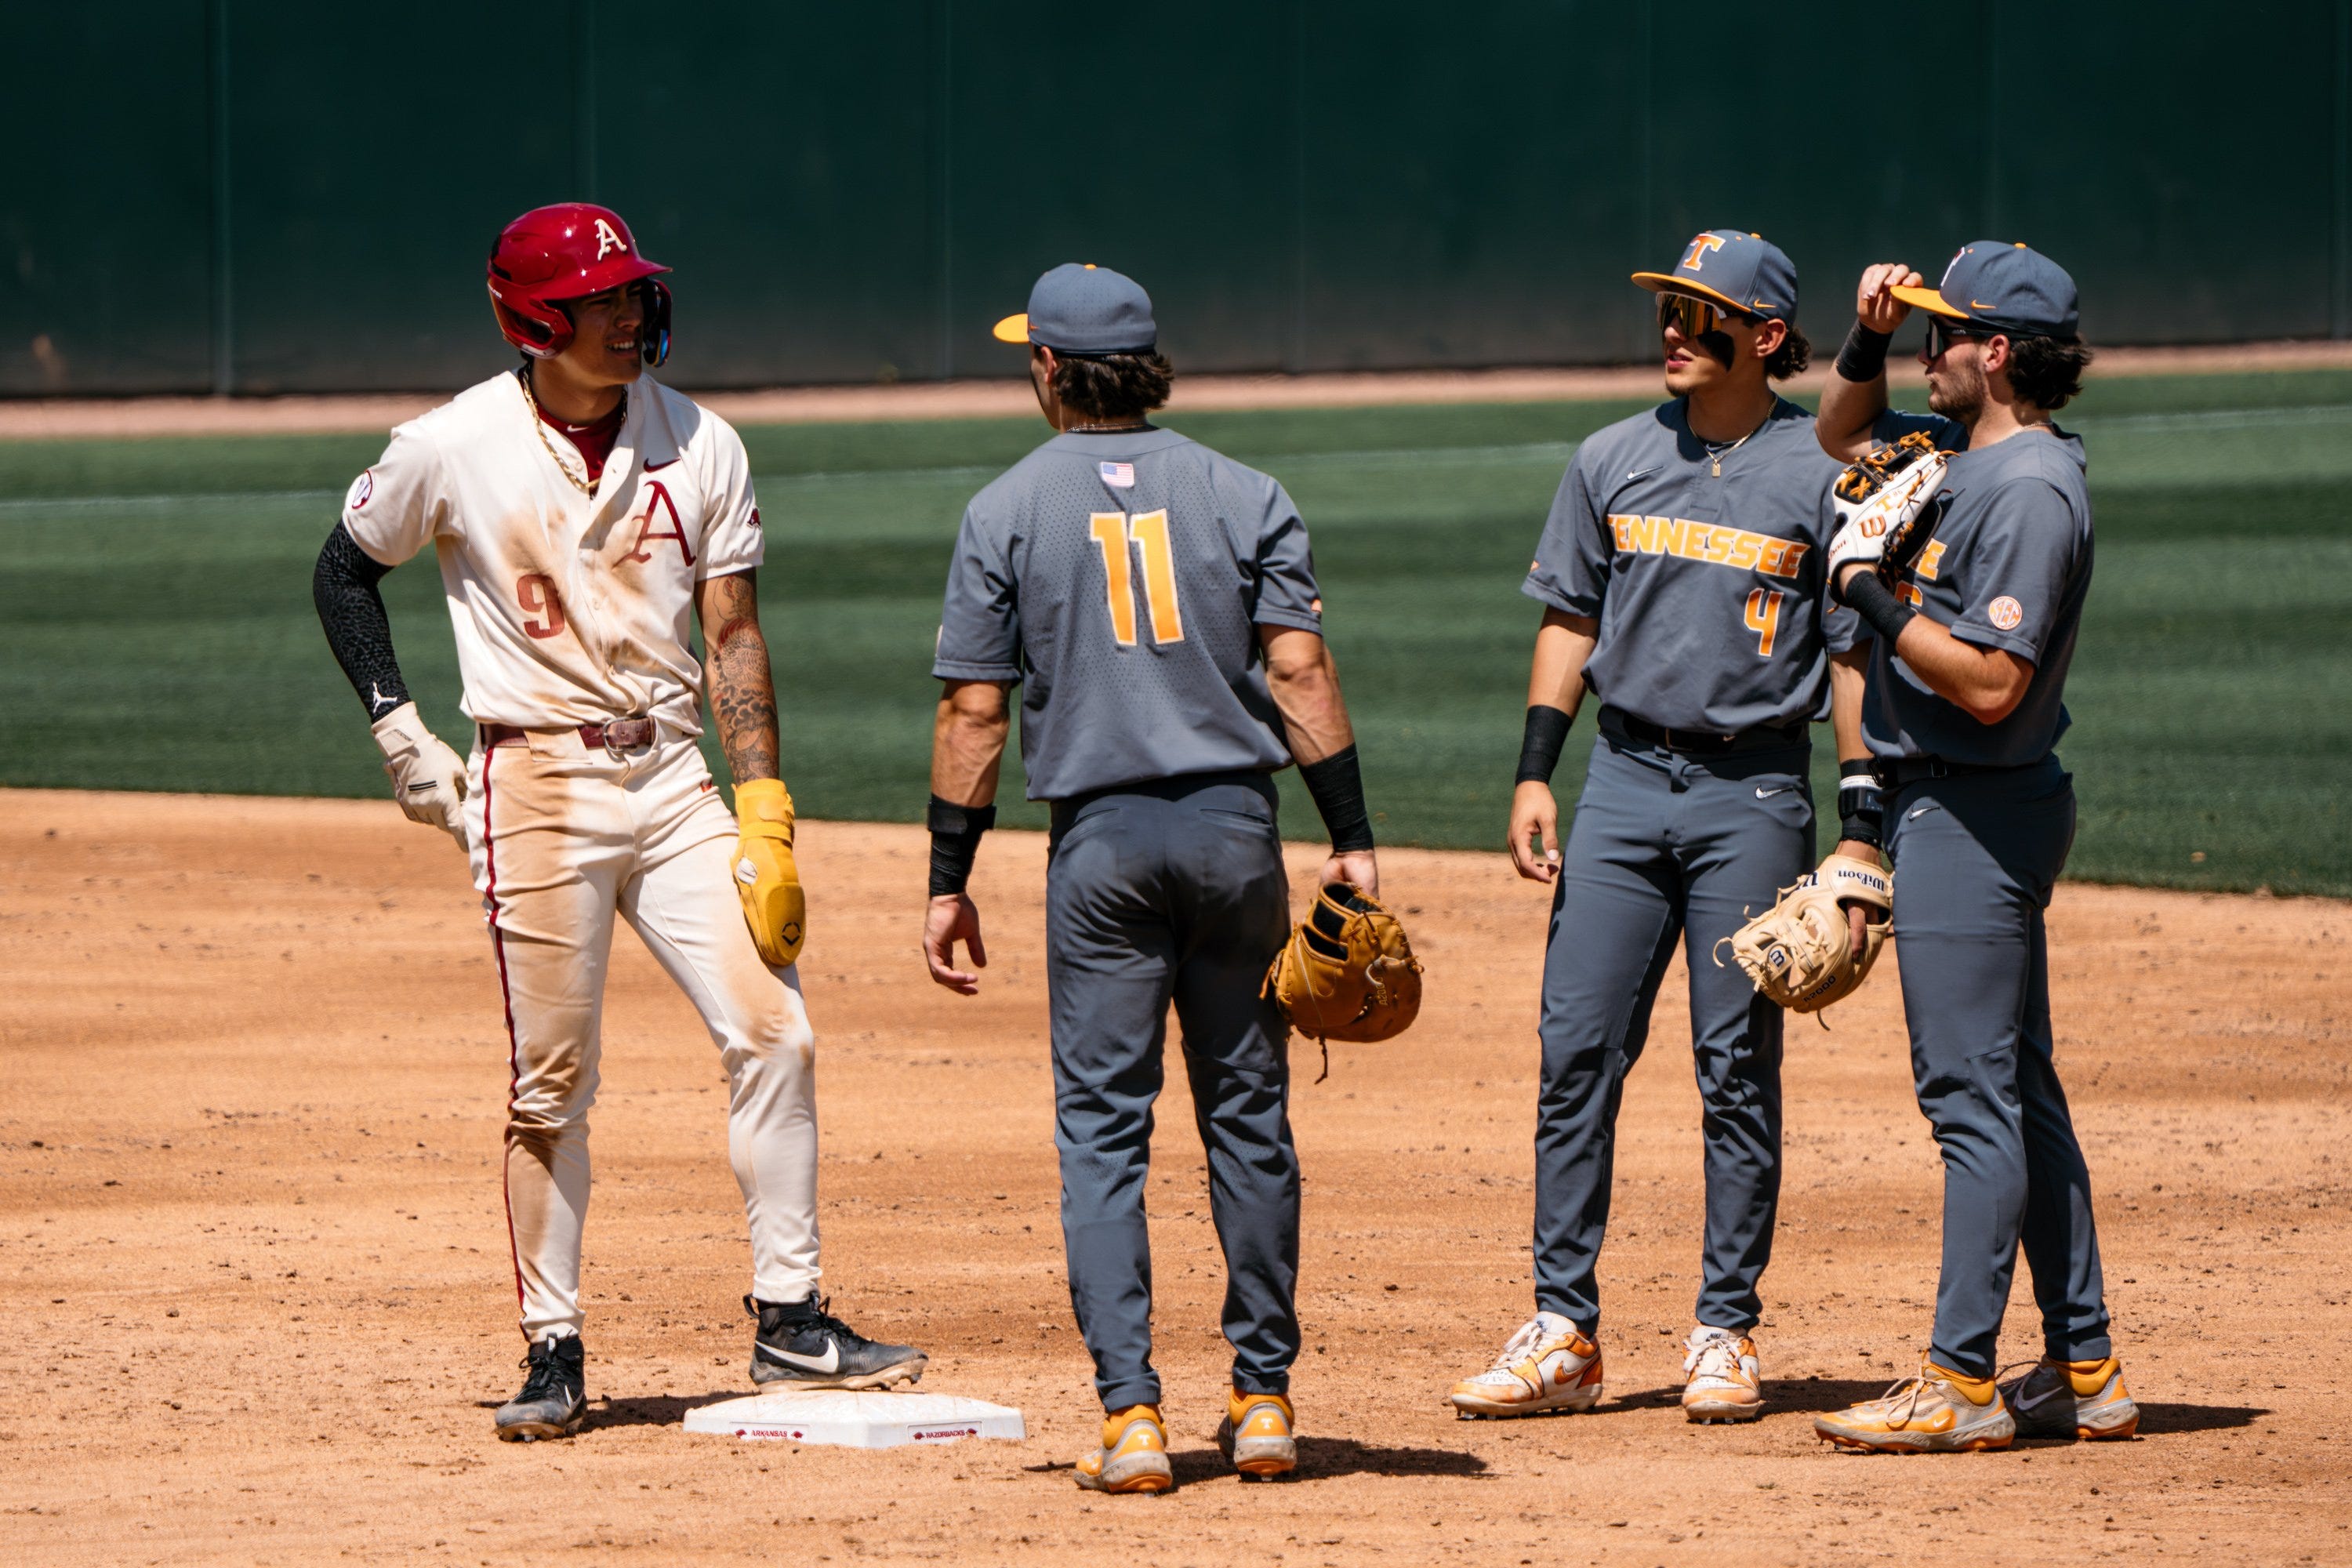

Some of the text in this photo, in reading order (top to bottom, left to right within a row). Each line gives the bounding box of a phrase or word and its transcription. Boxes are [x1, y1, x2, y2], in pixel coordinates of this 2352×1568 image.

[594, 219, 627, 261] A
[1682, 233, 1726, 272] T
[612, 480, 696, 567] A
[1089, 507, 1185, 646] 11
[517, 574, 565, 639] 9
[1744, 587, 1784, 657] 4
[1838, 869, 1886, 891] Wilson
[926, 1429, 965, 1439] RAZORBACKS
